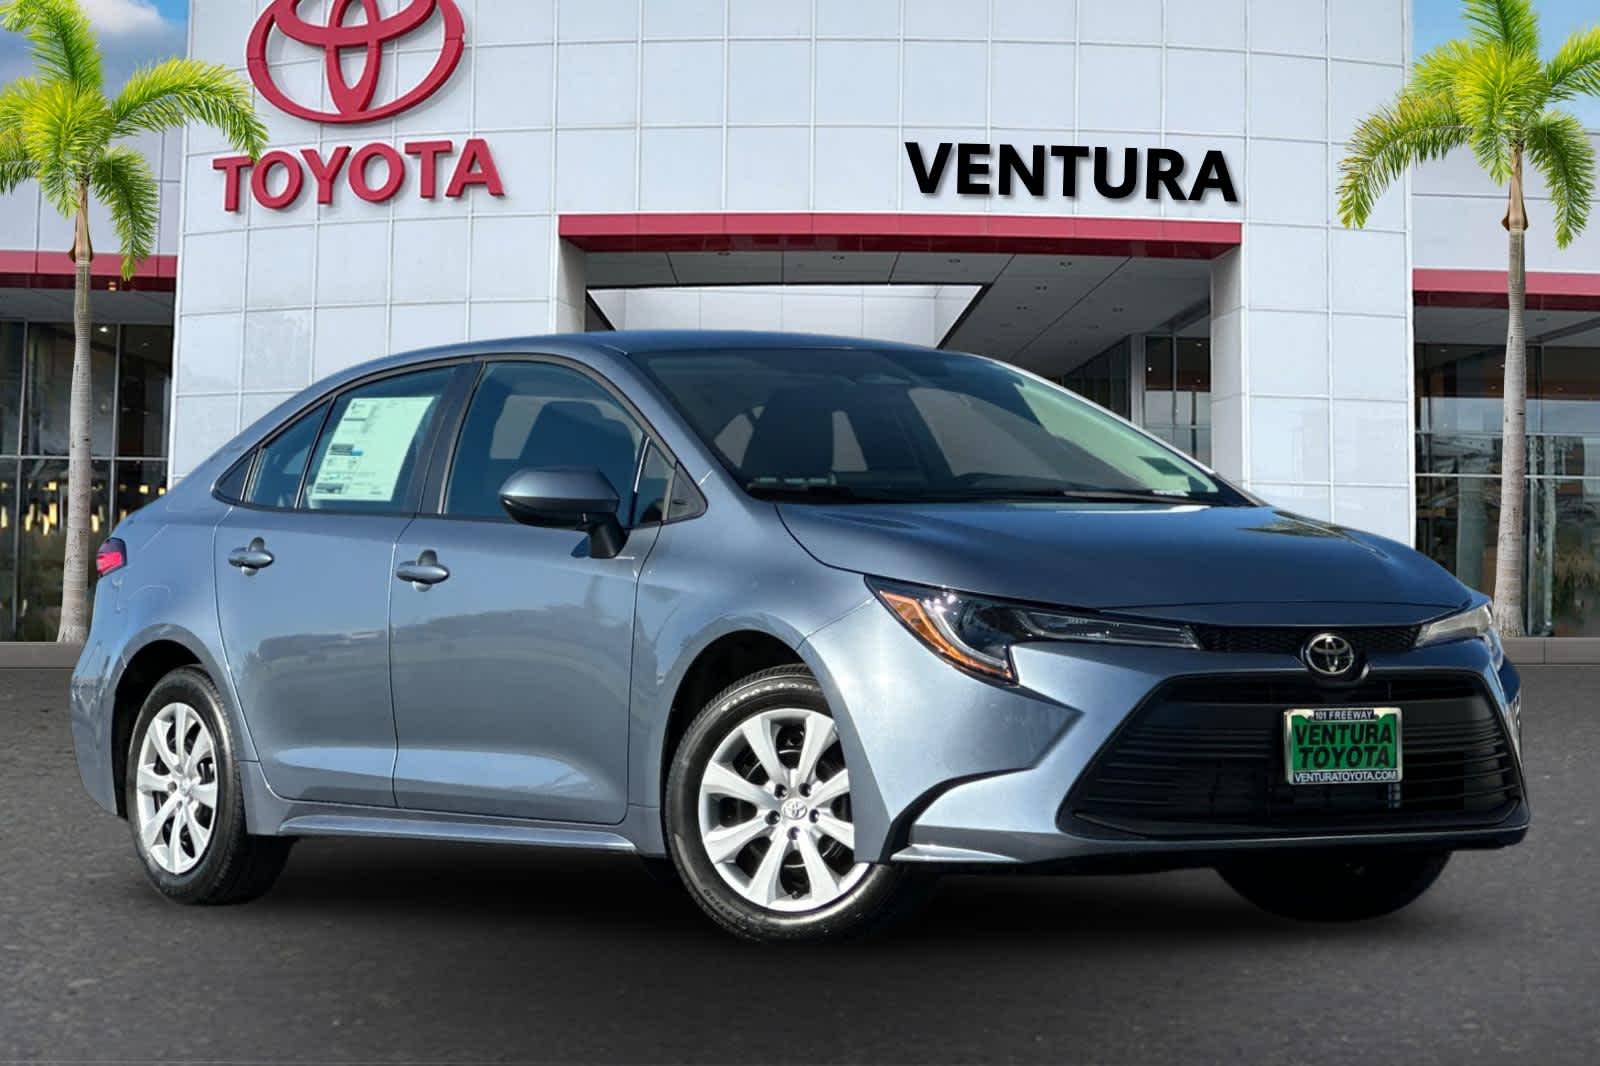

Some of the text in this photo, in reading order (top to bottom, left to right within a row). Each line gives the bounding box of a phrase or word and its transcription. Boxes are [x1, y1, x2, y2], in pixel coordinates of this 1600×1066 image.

[213, 138, 505, 212] TOYOTA
[904, 142, 1238, 203] VENTURA
[1315, 711, 1372, 720] 101 FREEWAY
[1294, 723, 1392, 745] VENTURA
[1299, 746, 1390, 768] TOYOTA
[1295, 771, 1396, 782] VENTURATOYOTA.COM
